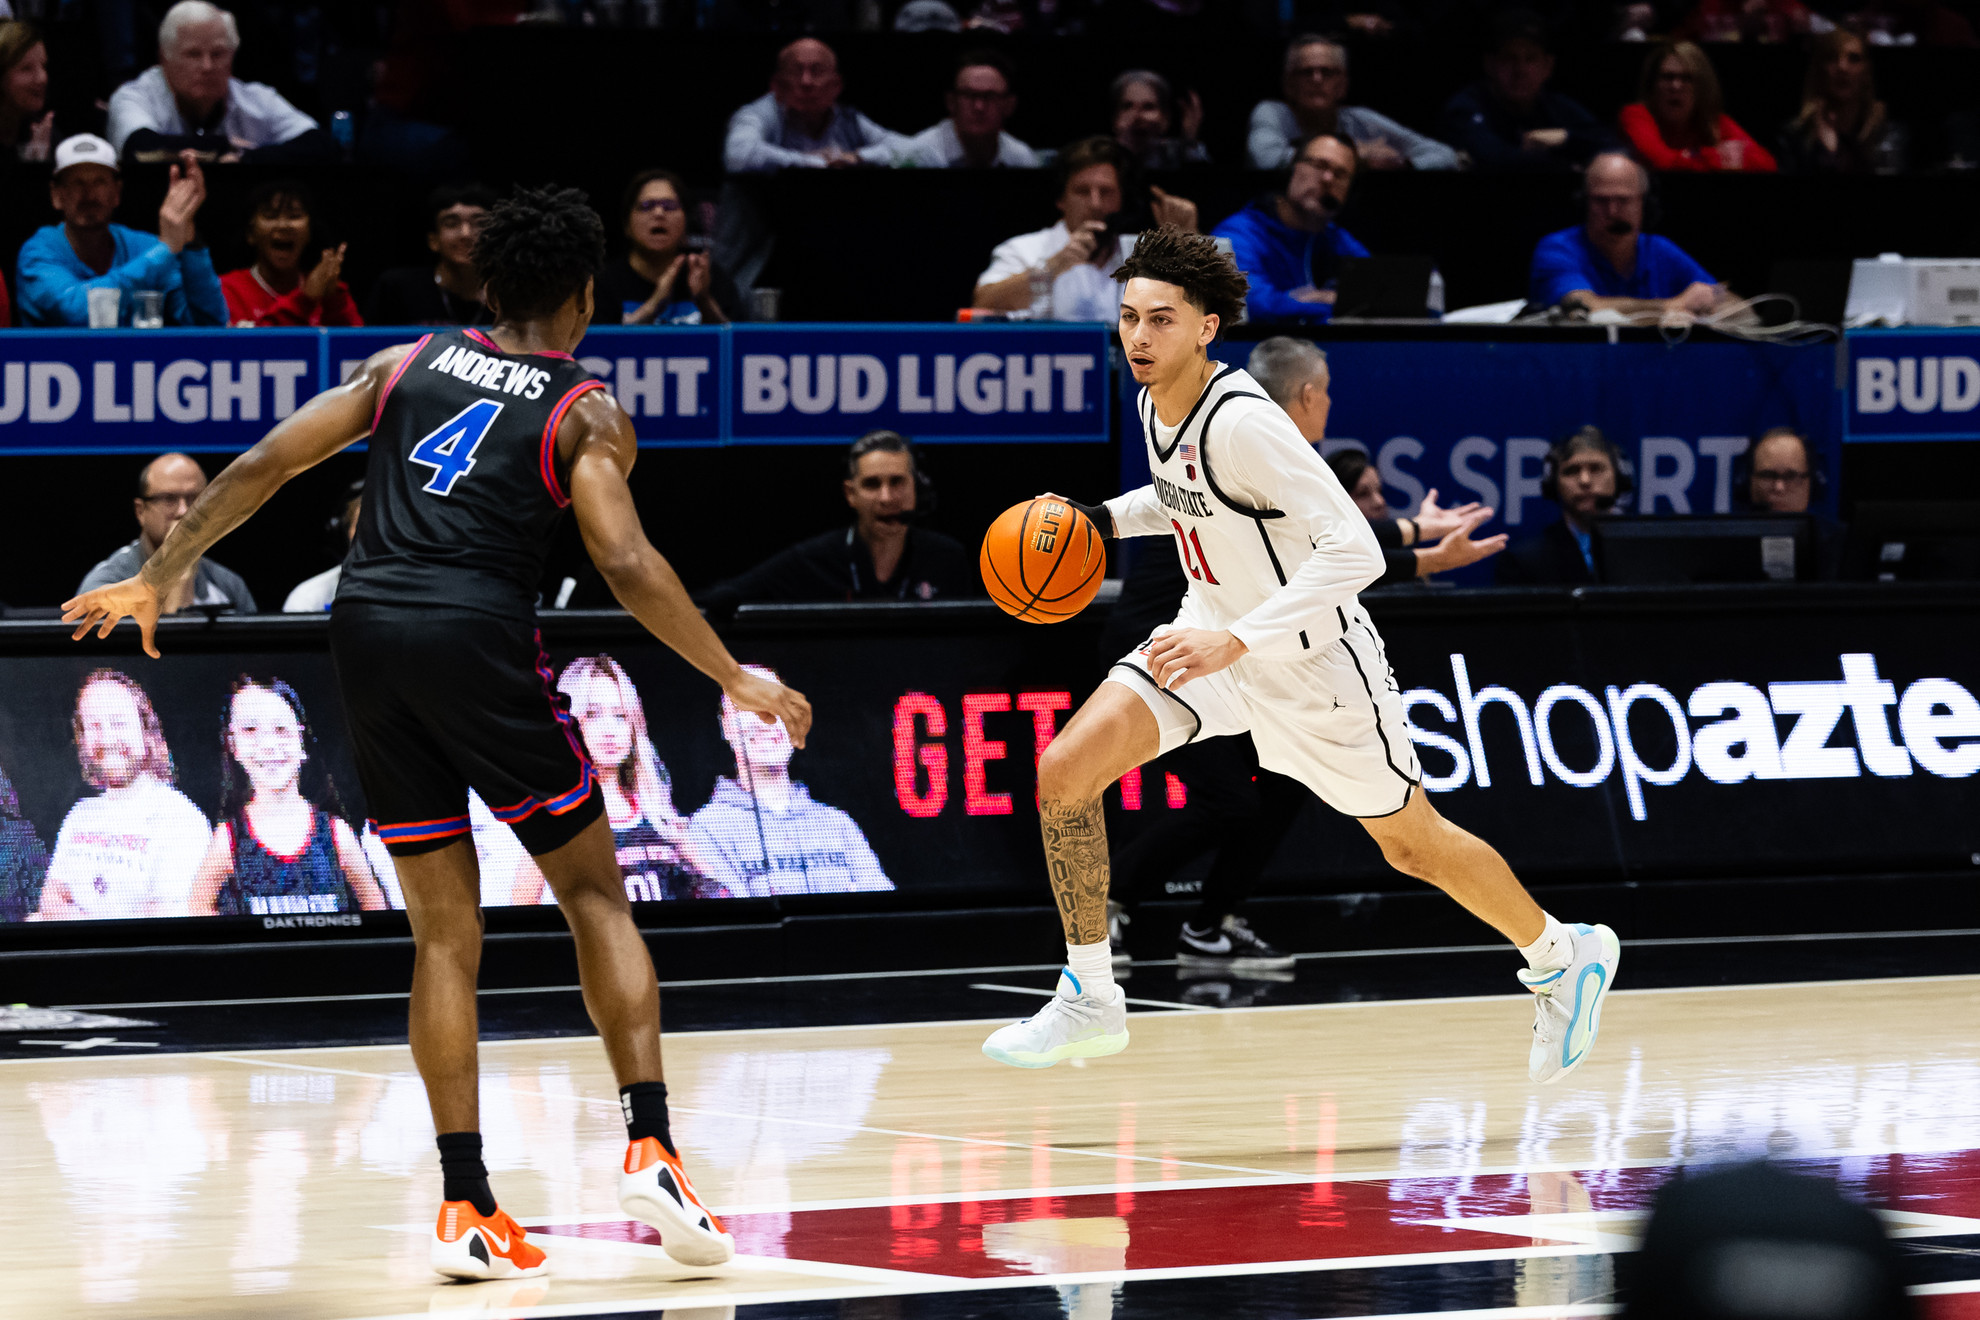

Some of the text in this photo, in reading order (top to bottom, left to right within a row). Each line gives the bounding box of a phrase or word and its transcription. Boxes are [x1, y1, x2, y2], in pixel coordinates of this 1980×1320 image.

[93, 359, 308, 424] LIGHT
[428, 345, 551, 400] ANDREWS
[742, 352, 1095, 415] BUD LIGHT
[1856, 355, 1980, 414] BUD
[408, 398, 505, 497] 4
[1036, 502, 1065, 553] ELITE
[1178, 486, 1214, 518] STATE
[1171, 518, 1221, 586] 21
[263, 914, 362, 929] DAKTRONICS
